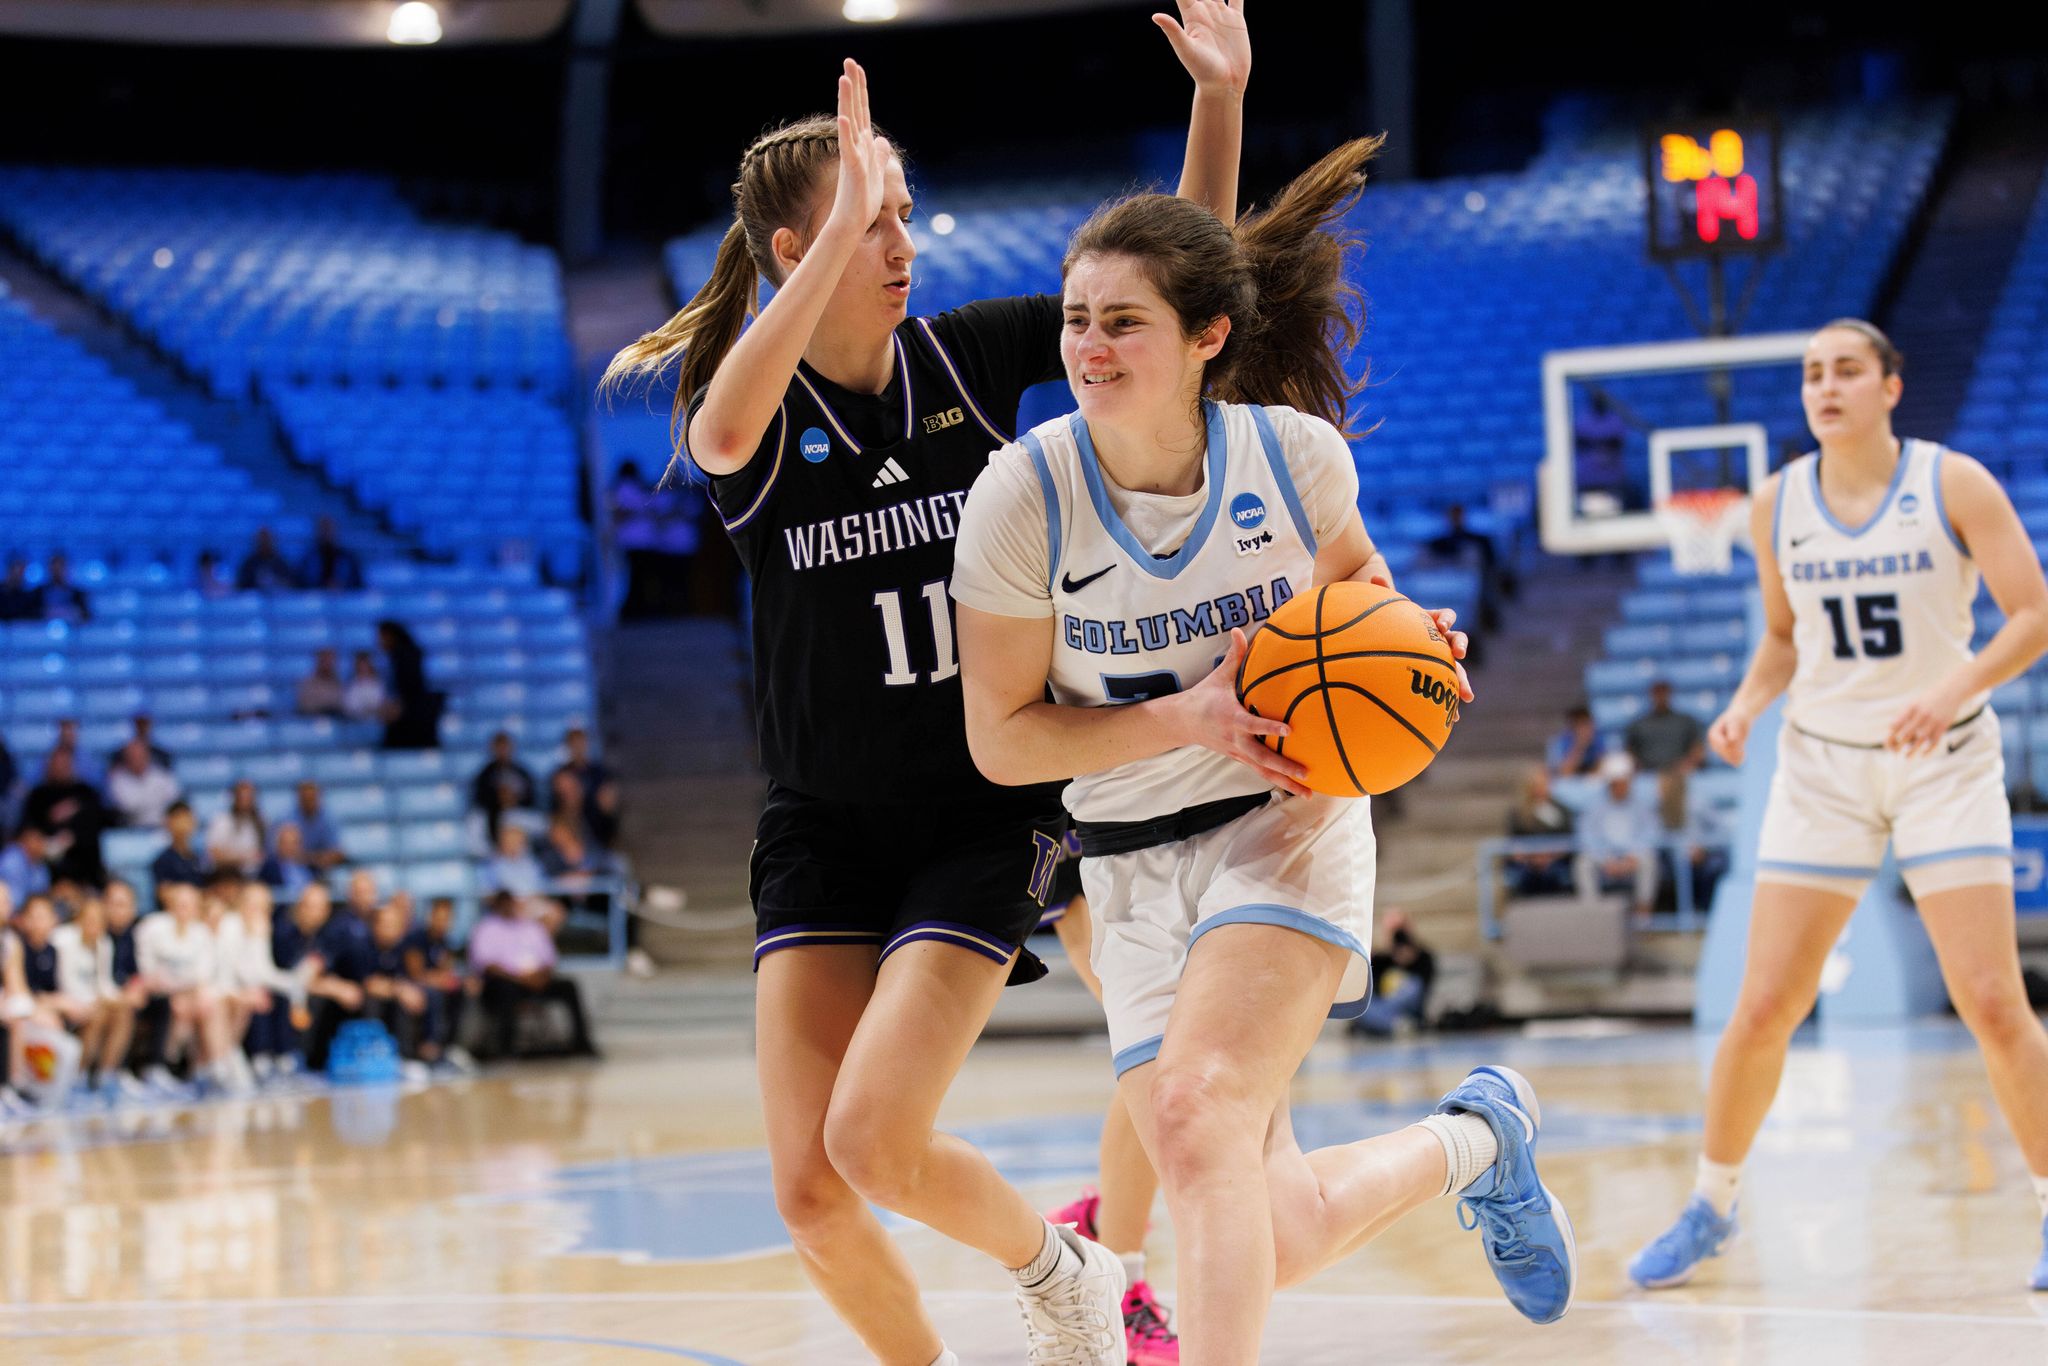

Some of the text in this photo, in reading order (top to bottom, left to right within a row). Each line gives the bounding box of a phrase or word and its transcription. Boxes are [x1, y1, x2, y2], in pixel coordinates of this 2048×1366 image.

[804, 443, 829, 454] NCAA
[784, 489, 971, 570] WASHINGT
[1236, 506, 1265, 521] NCAA
[1237, 536, 1260, 552] Ivy
[1792, 551, 1934, 582] COLUMBIA
[871, 576, 959, 686] 11
[1064, 576, 1294, 655] COLUMBIA
[1821, 593, 1904, 660] 15
[1411, 668, 1459, 728] lson
